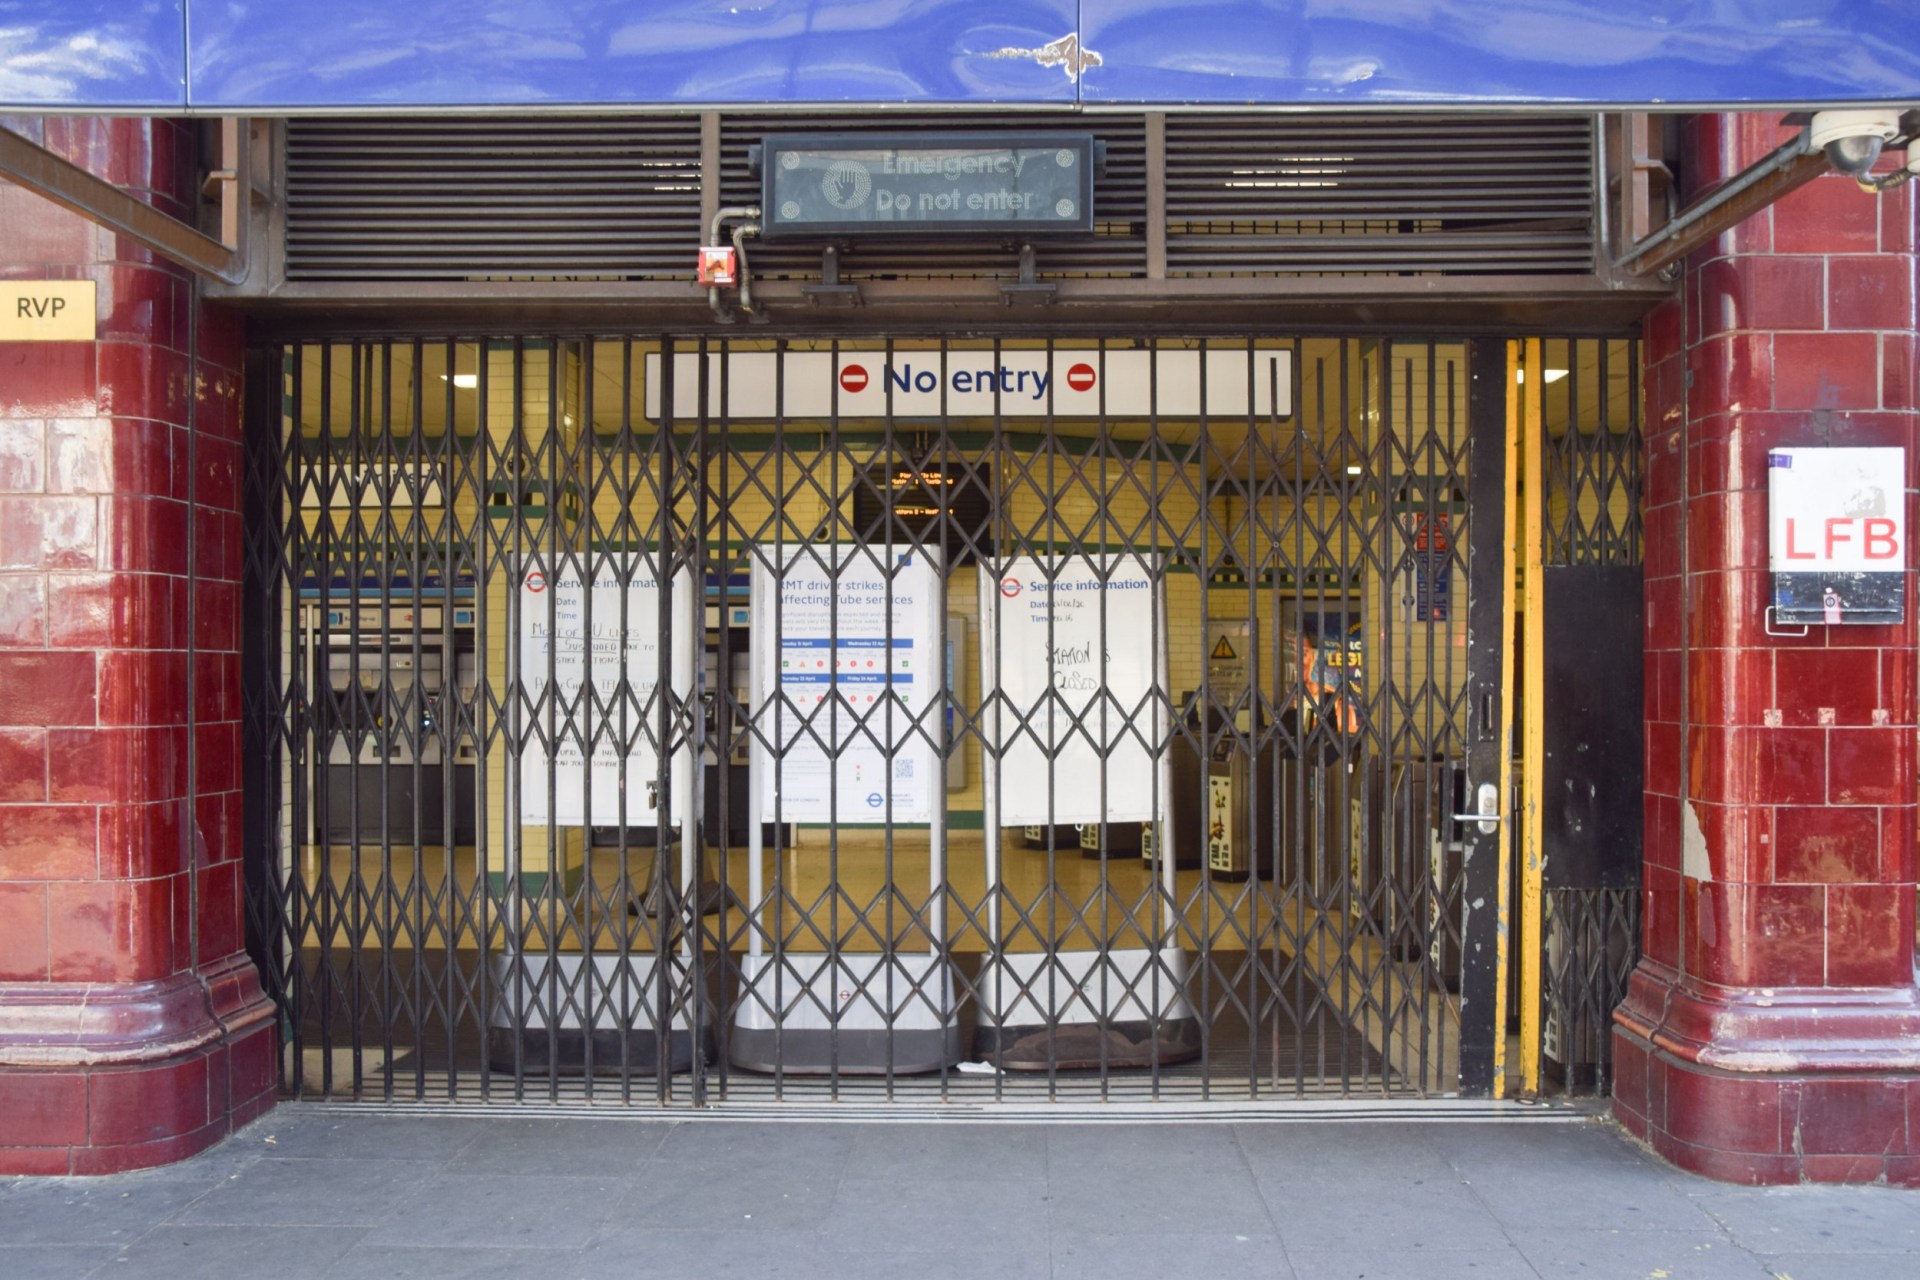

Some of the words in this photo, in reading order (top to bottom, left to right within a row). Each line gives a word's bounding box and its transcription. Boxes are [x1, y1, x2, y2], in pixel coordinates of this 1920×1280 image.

[883, 152, 1026, 181] Emergency
[876, 188, 911, 211] Do
[919, 188, 960, 210] not
[967, 188, 1034, 211] enter
[17, 297, 66, 318] RVP
[883, 364, 937, 393] No
[952, 366, 1049, 400] entry
[1785, 518, 1899, 560] LFB
[807, 580, 842, 591] drivr
[845, 580, 884, 591] strikes
[1076, 579, 1148, 590] infomation
